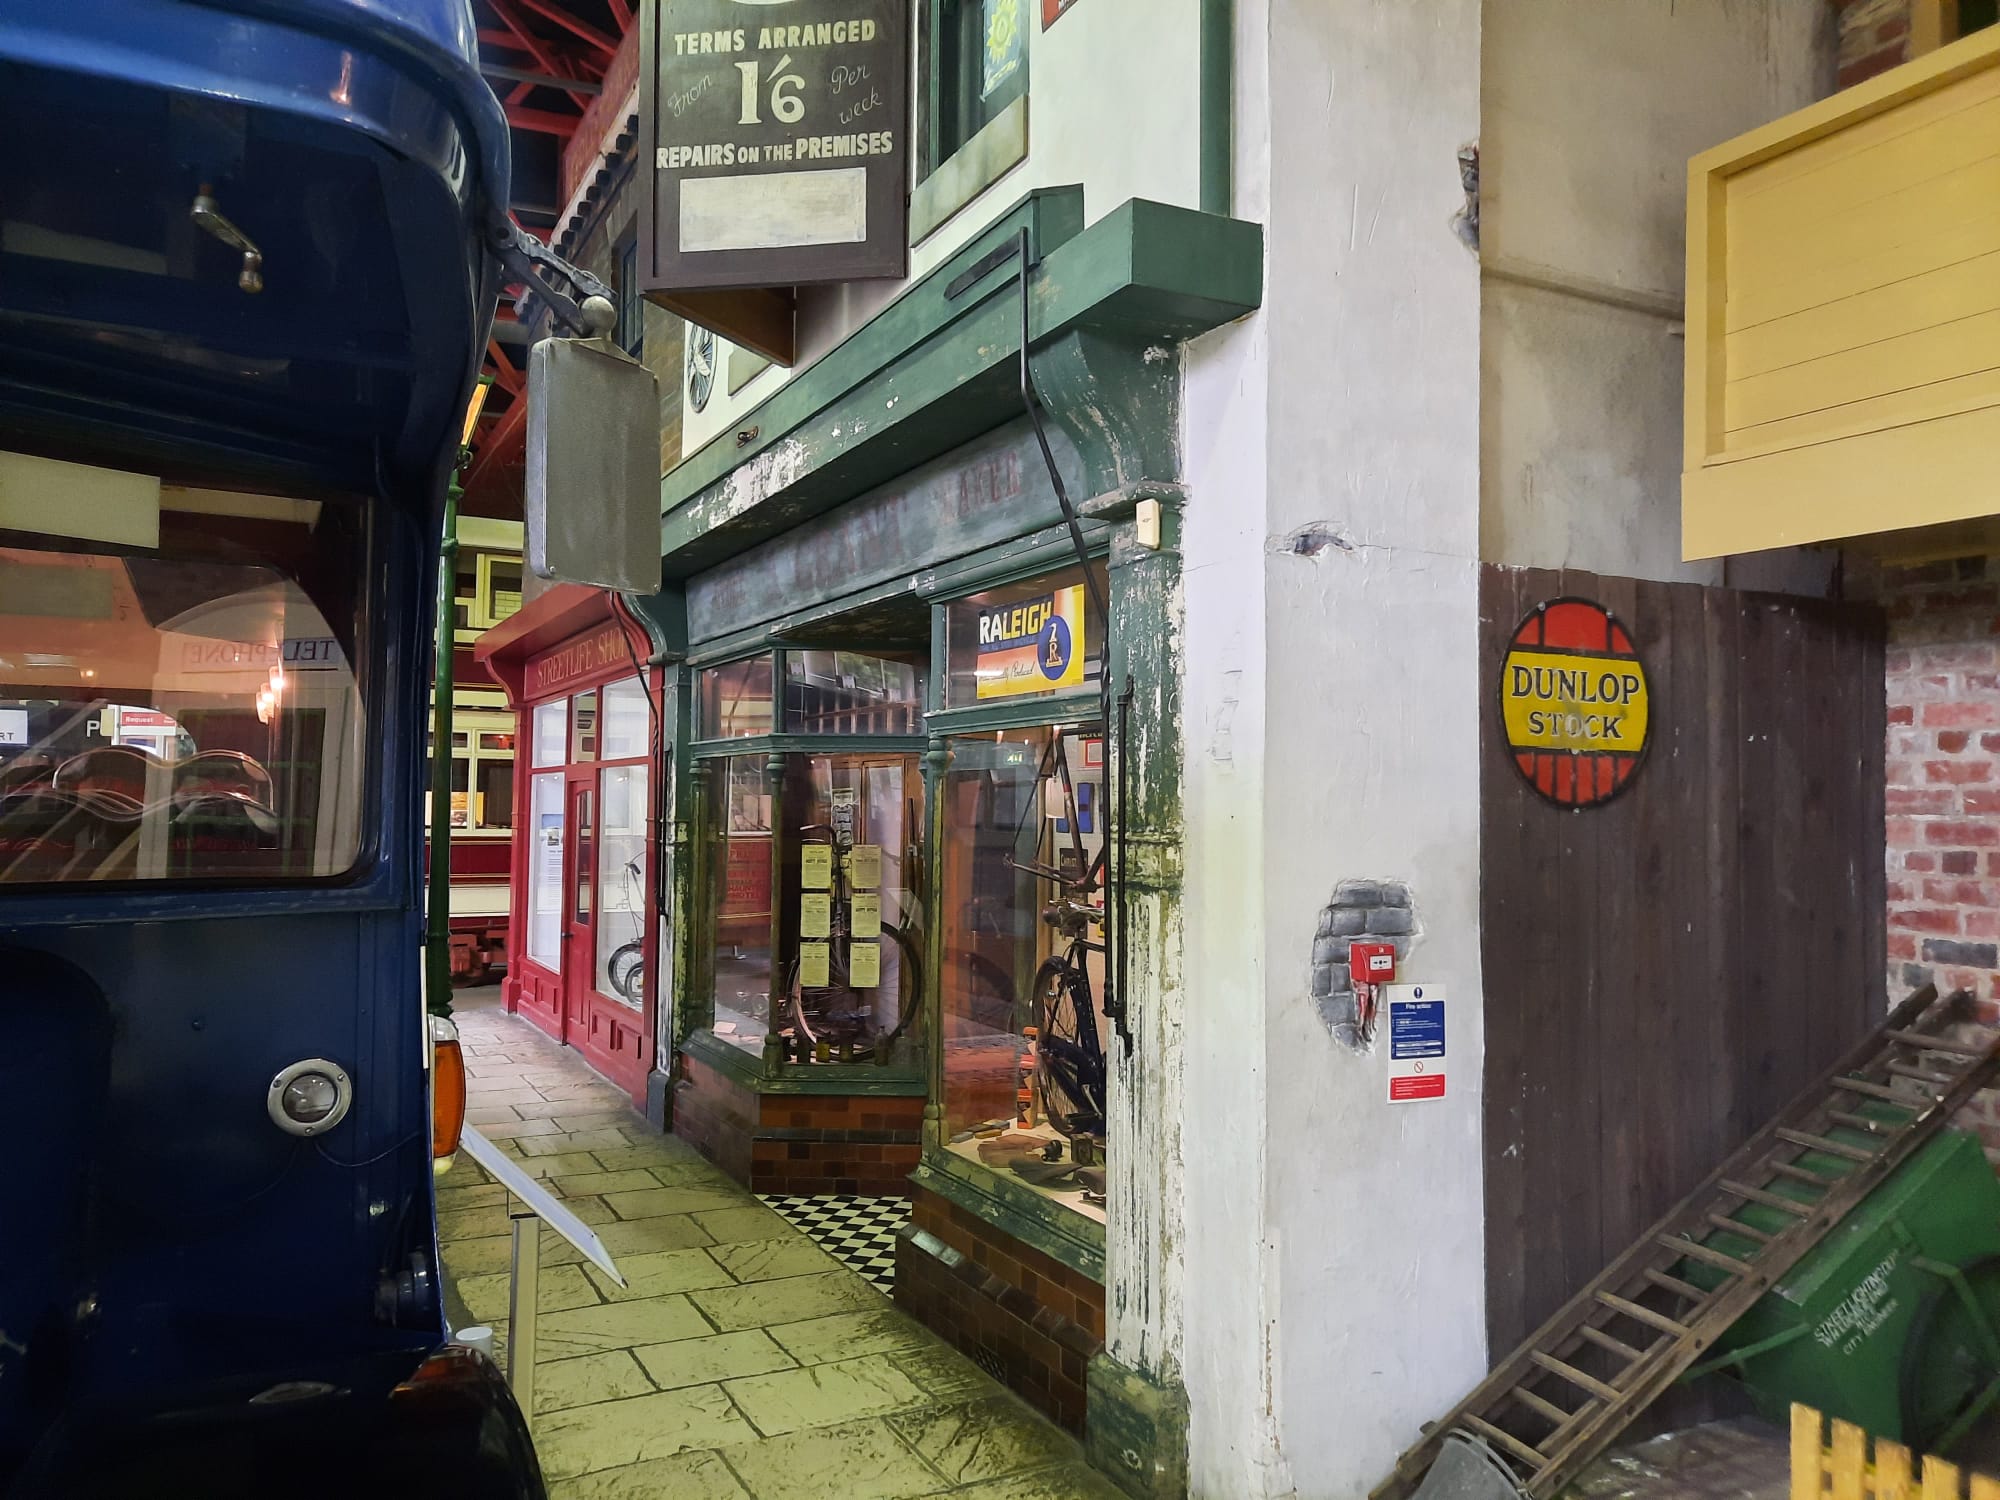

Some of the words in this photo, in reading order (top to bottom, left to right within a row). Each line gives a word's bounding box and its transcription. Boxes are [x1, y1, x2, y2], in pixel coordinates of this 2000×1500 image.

[674, 29, 745, 56] TERMS
[758, 19, 876, 50] ARRANGED
[667, 74, 712, 118] From
[831, 63, 871, 94] Per
[839, 86, 883, 125] week
[656, 143, 735, 169] REPAIRS
[737, 147, 760, 164] ON
[765, 144, 793, 161] THE
[795, 131, 893, 160] PREMISES
[979, 601, 1052, 645] RALEIGH
[1511, 664, 1640, 705] DUNLOP
[1528, 711, 1624, 739] STOCK
